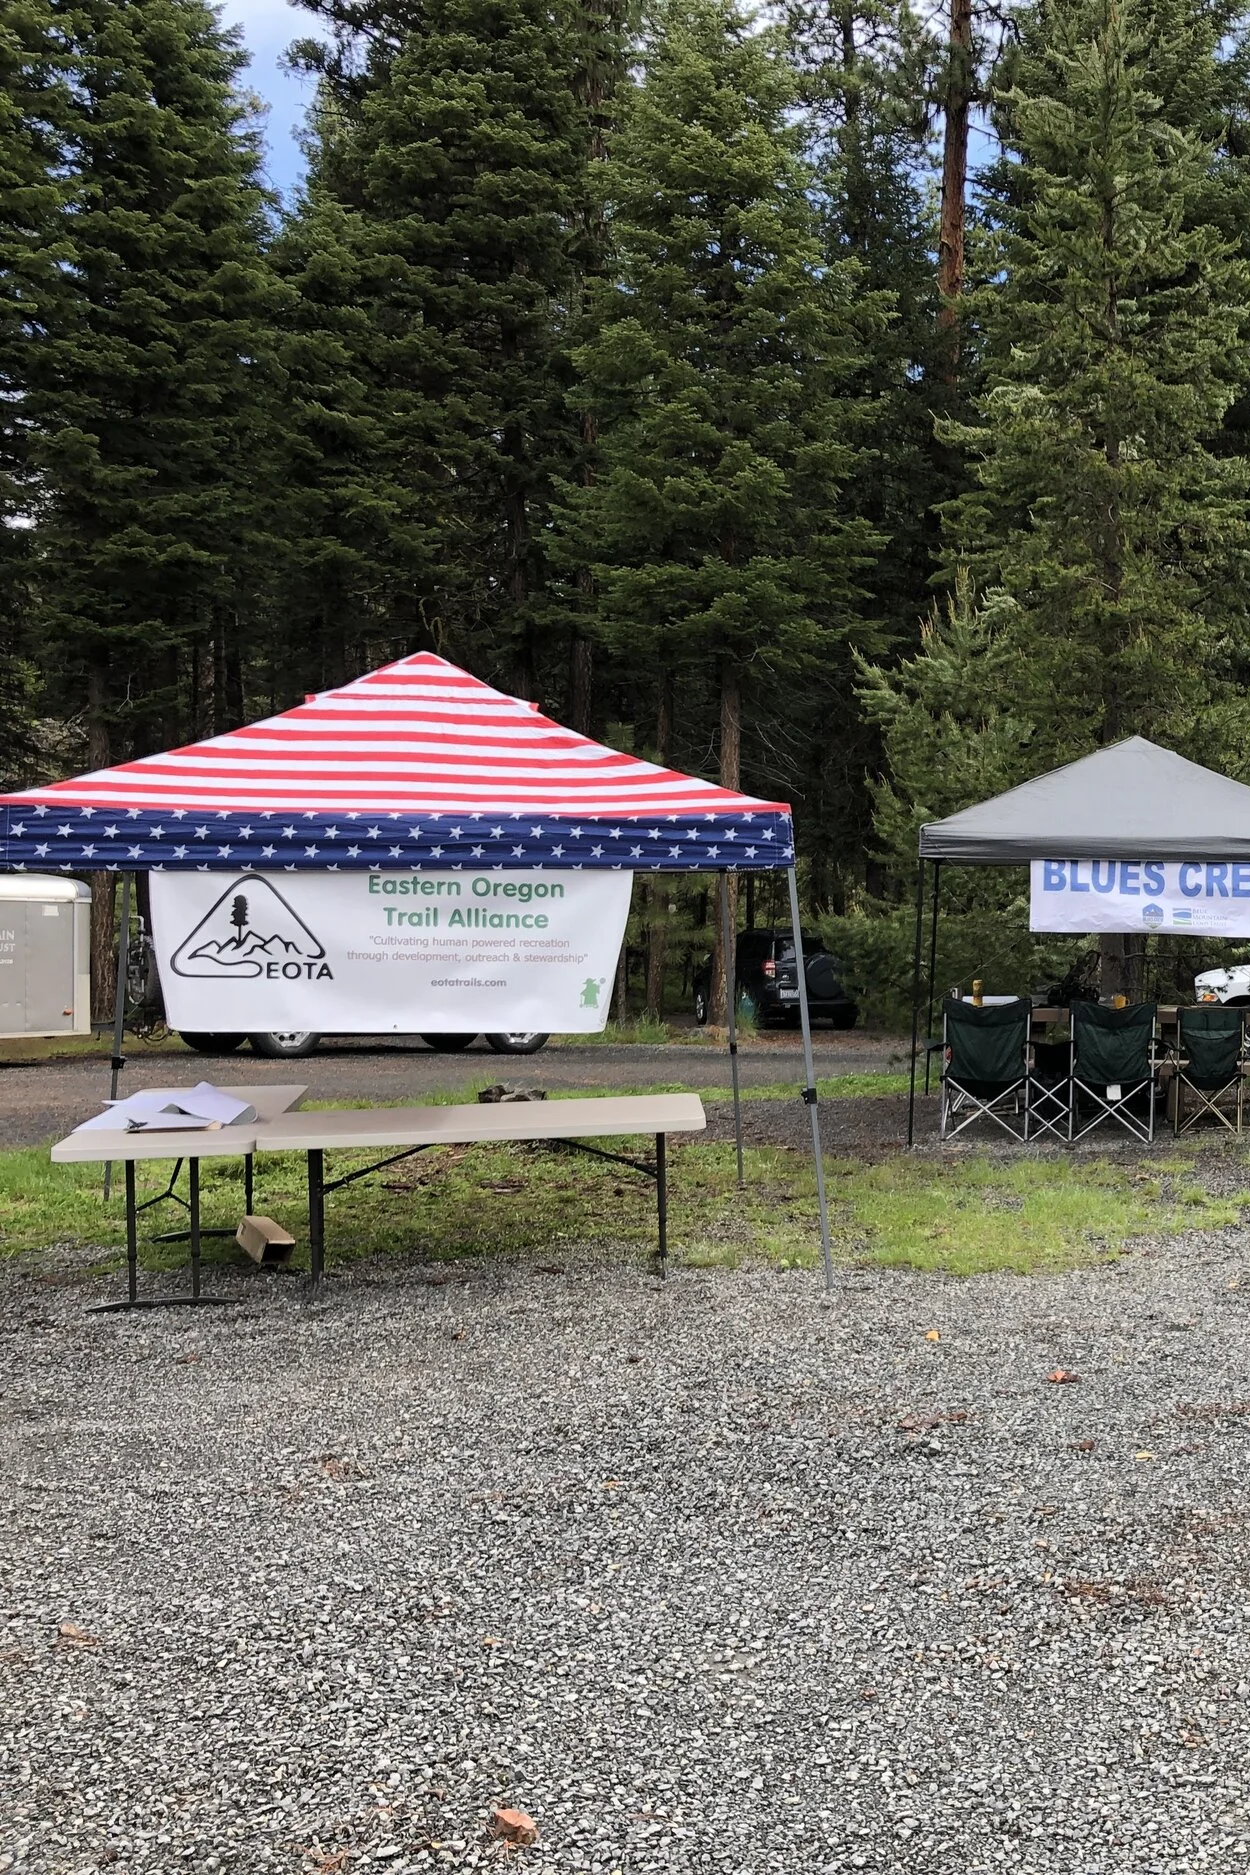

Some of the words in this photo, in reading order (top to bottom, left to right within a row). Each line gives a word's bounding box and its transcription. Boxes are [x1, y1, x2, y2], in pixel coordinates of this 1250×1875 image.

[1043, 859, 1165, 897] BLUES
[368, 874, 461, 896] Eastern
[471, 877, 564, 903] Oregon
[383, 907, 439, 928] Trail
[448, 907, 549, 929] Alliance
[369, 935, 428, 948] "Cultivating
[432, 937, 468, 947] human
[471, 937, 516, 949] powered
[519, 938, 570, 948] recreation
[347, 950, 389, 963] through
[392, 951, 462, 964] development,
[465, 952, 509, 963] outreach
[512, 953, 521, 963] &
[524, 953, 589, 965] stewardship"
[266, 962, 334, 980] EOTA
[430, 977, 507, 988] eotatrails.com
